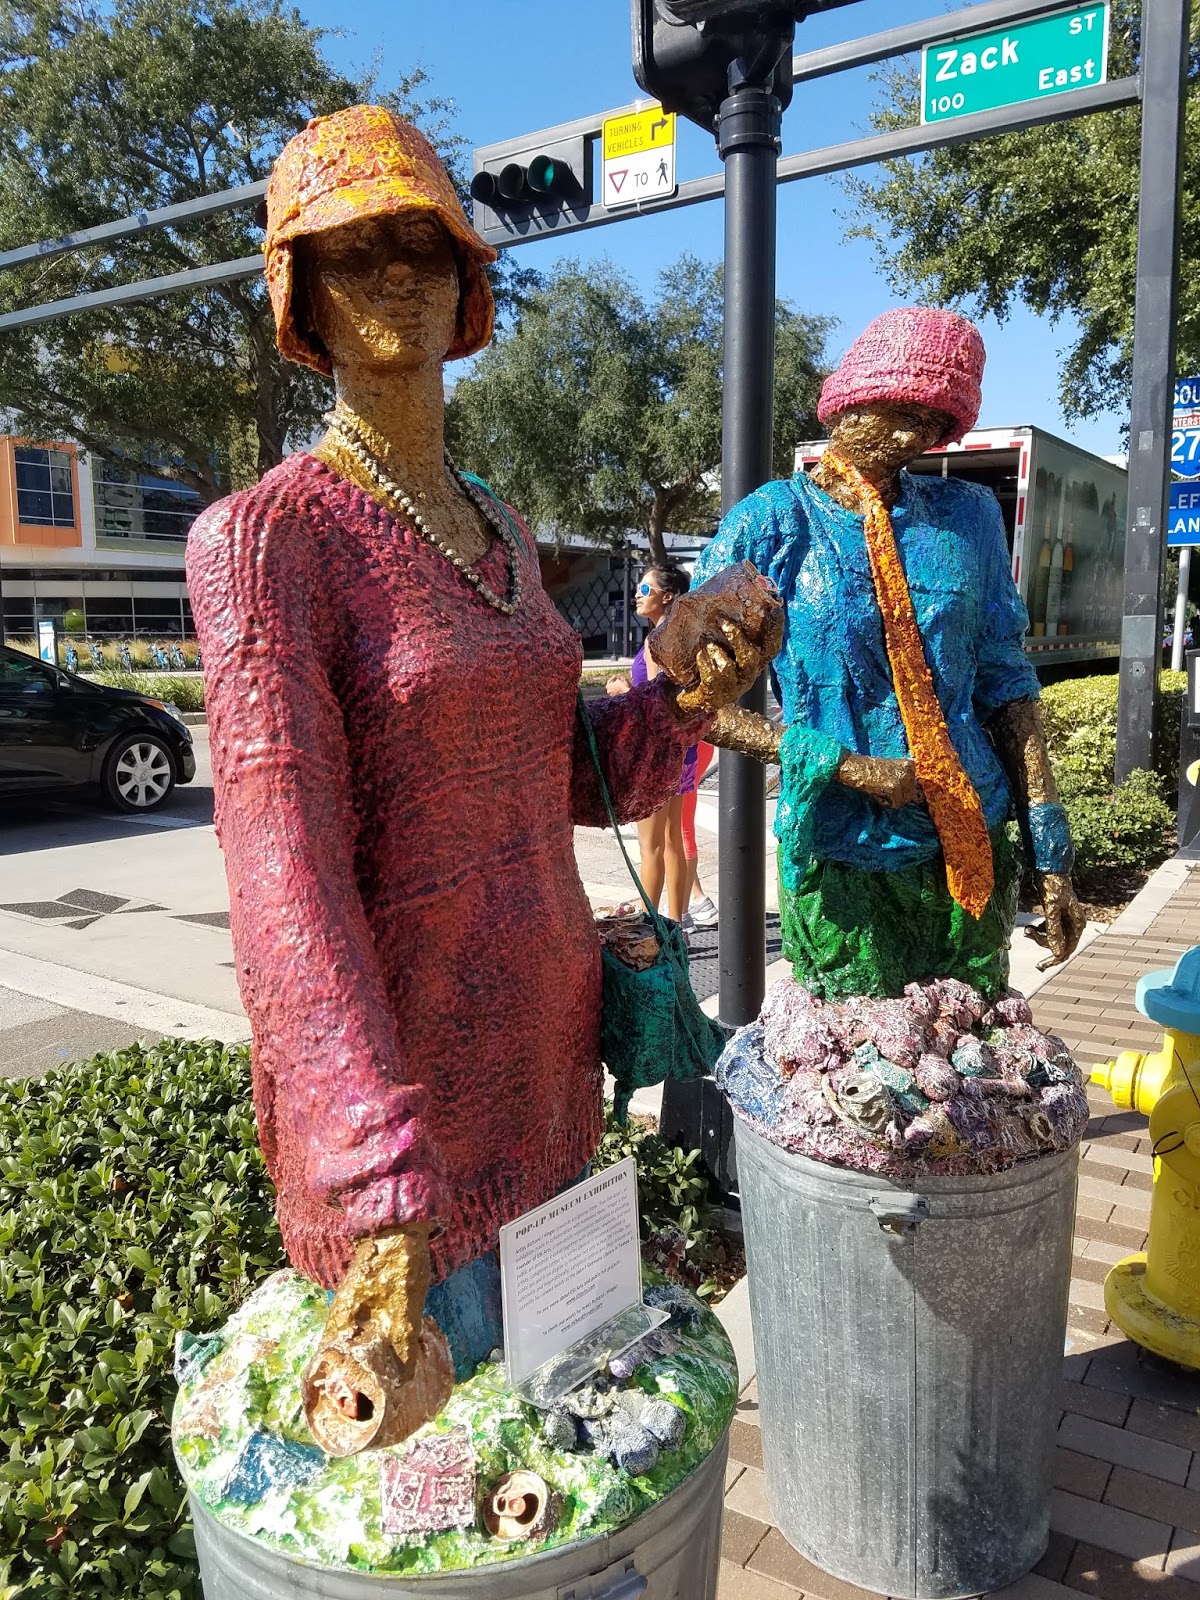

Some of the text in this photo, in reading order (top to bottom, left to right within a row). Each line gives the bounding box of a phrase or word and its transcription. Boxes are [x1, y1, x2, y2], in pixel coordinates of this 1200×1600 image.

[935, 12, 1097, 83] Zack ST
[930, 58, 1095, 115] 100 East
[609, 121, 642, 138] TURNING
[607, 136, 644, 153] VEHICLES
[634, 172, 649, 187] TO
[1169, 493, 1200, 510] EF
[1167, 517, 1200, 534] AN
[515, 1215, 547, 1240] POP-UP
[549, 1195, 582, 1220] MUSEUM
[583, 1170, 628, 1201] EXHIBITION
